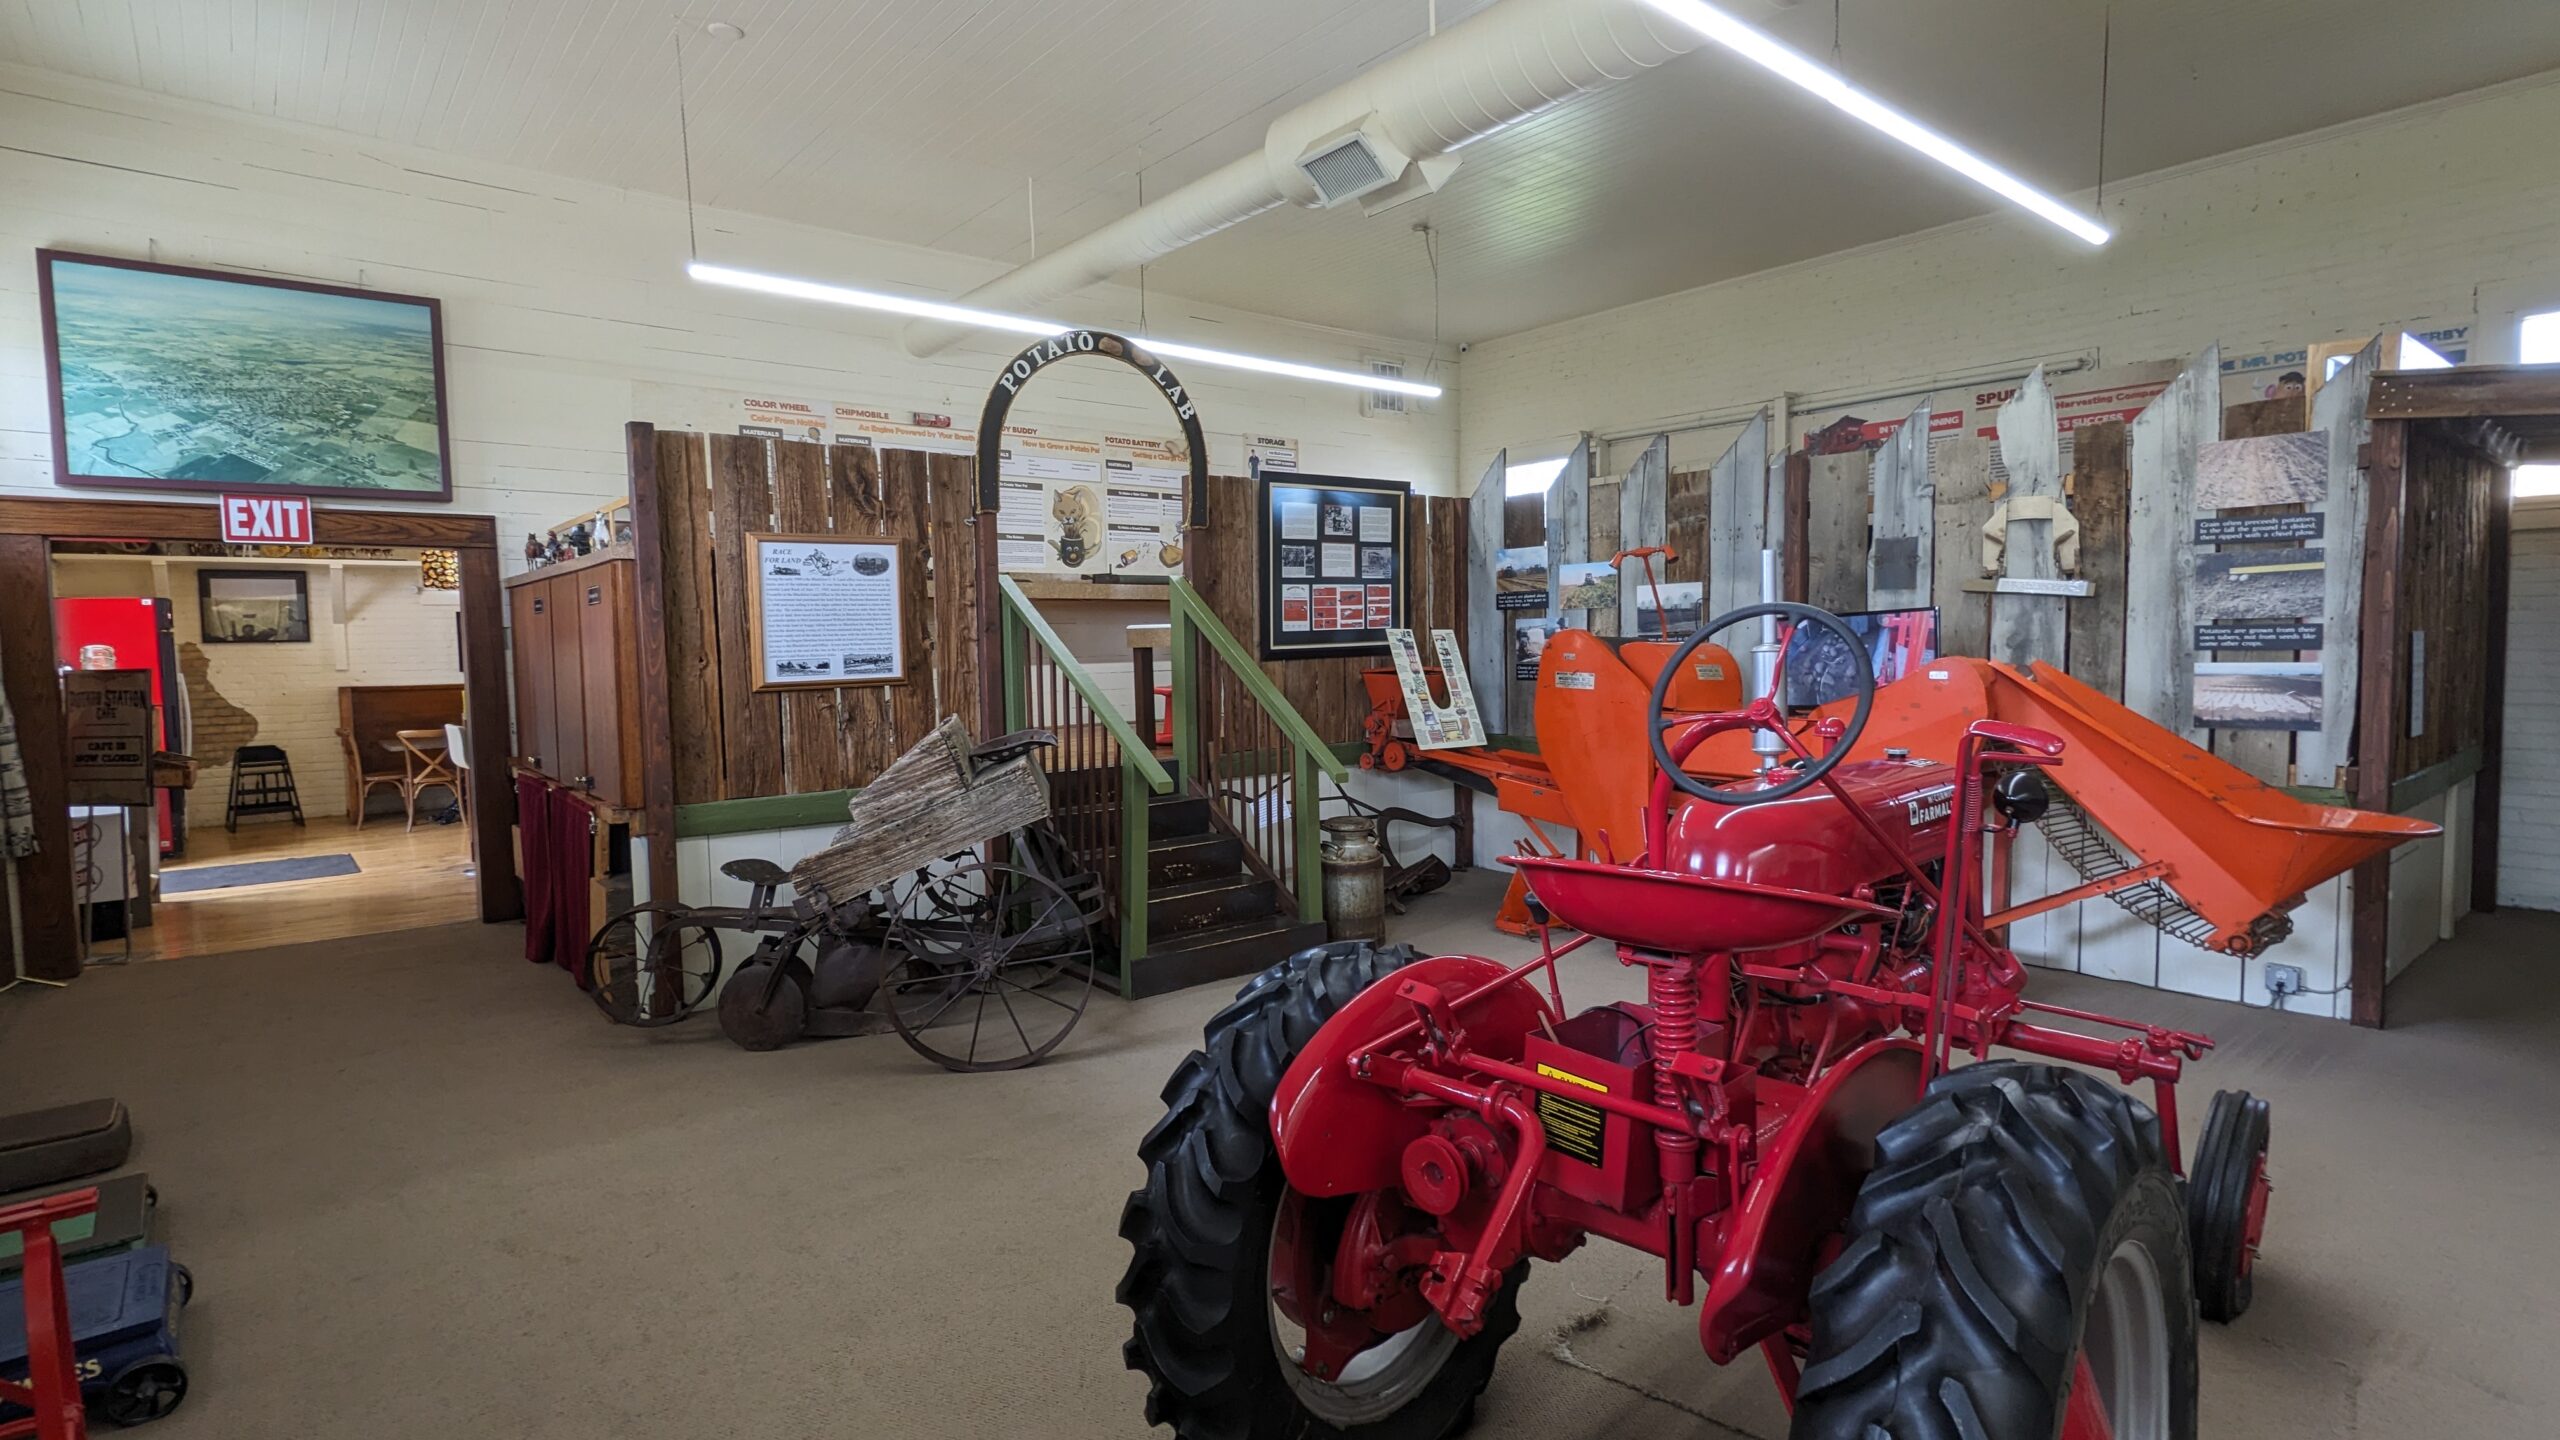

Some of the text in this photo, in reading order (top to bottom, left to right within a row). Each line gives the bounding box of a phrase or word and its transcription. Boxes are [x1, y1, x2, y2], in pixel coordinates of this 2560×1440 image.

[1000, 332, 1195, 421] POTATO LAB
[743, 399, 811, 413] COLOR WHEEL
[2056, 393, 2113, 410] Harvesting
[750, 413, 774, 421] Color
[775, 416, 796, 426] From
[835, 407, 889, 420] CHIPMOBILE
[2072, 412, 2124, 428] SUCCESS
[742, 429, 780, 437] MATERIALS
[871, 425, 894, 435] Engine
[895, 427, 926, 437] Powered
[937, 430, 953, 440] Your
[954, 432, 976, 442] Breath
[1012, 426, 1038, 435] BUDDY
[1023, 440, 1038, 448] How
[1070, 444, 1089, 453] Potato
[1104, 436, 1161, 448] POTATO BATTERY
[1257, 437, 1286, 447] STORAGE
[228, 498, 304, 538] EXIT
[2281, 516, 2317, 525] potatoes.
[2244, 531, 2261, 539] with
[2271, 530, 2293, 538] chisel
[2252, 525, 2278, 533] ground
[765, 556, 801, 564] FOR LAND
[116, 742, 127, 751] IS
[75, 754, 140, 763] NOW CLOSED
